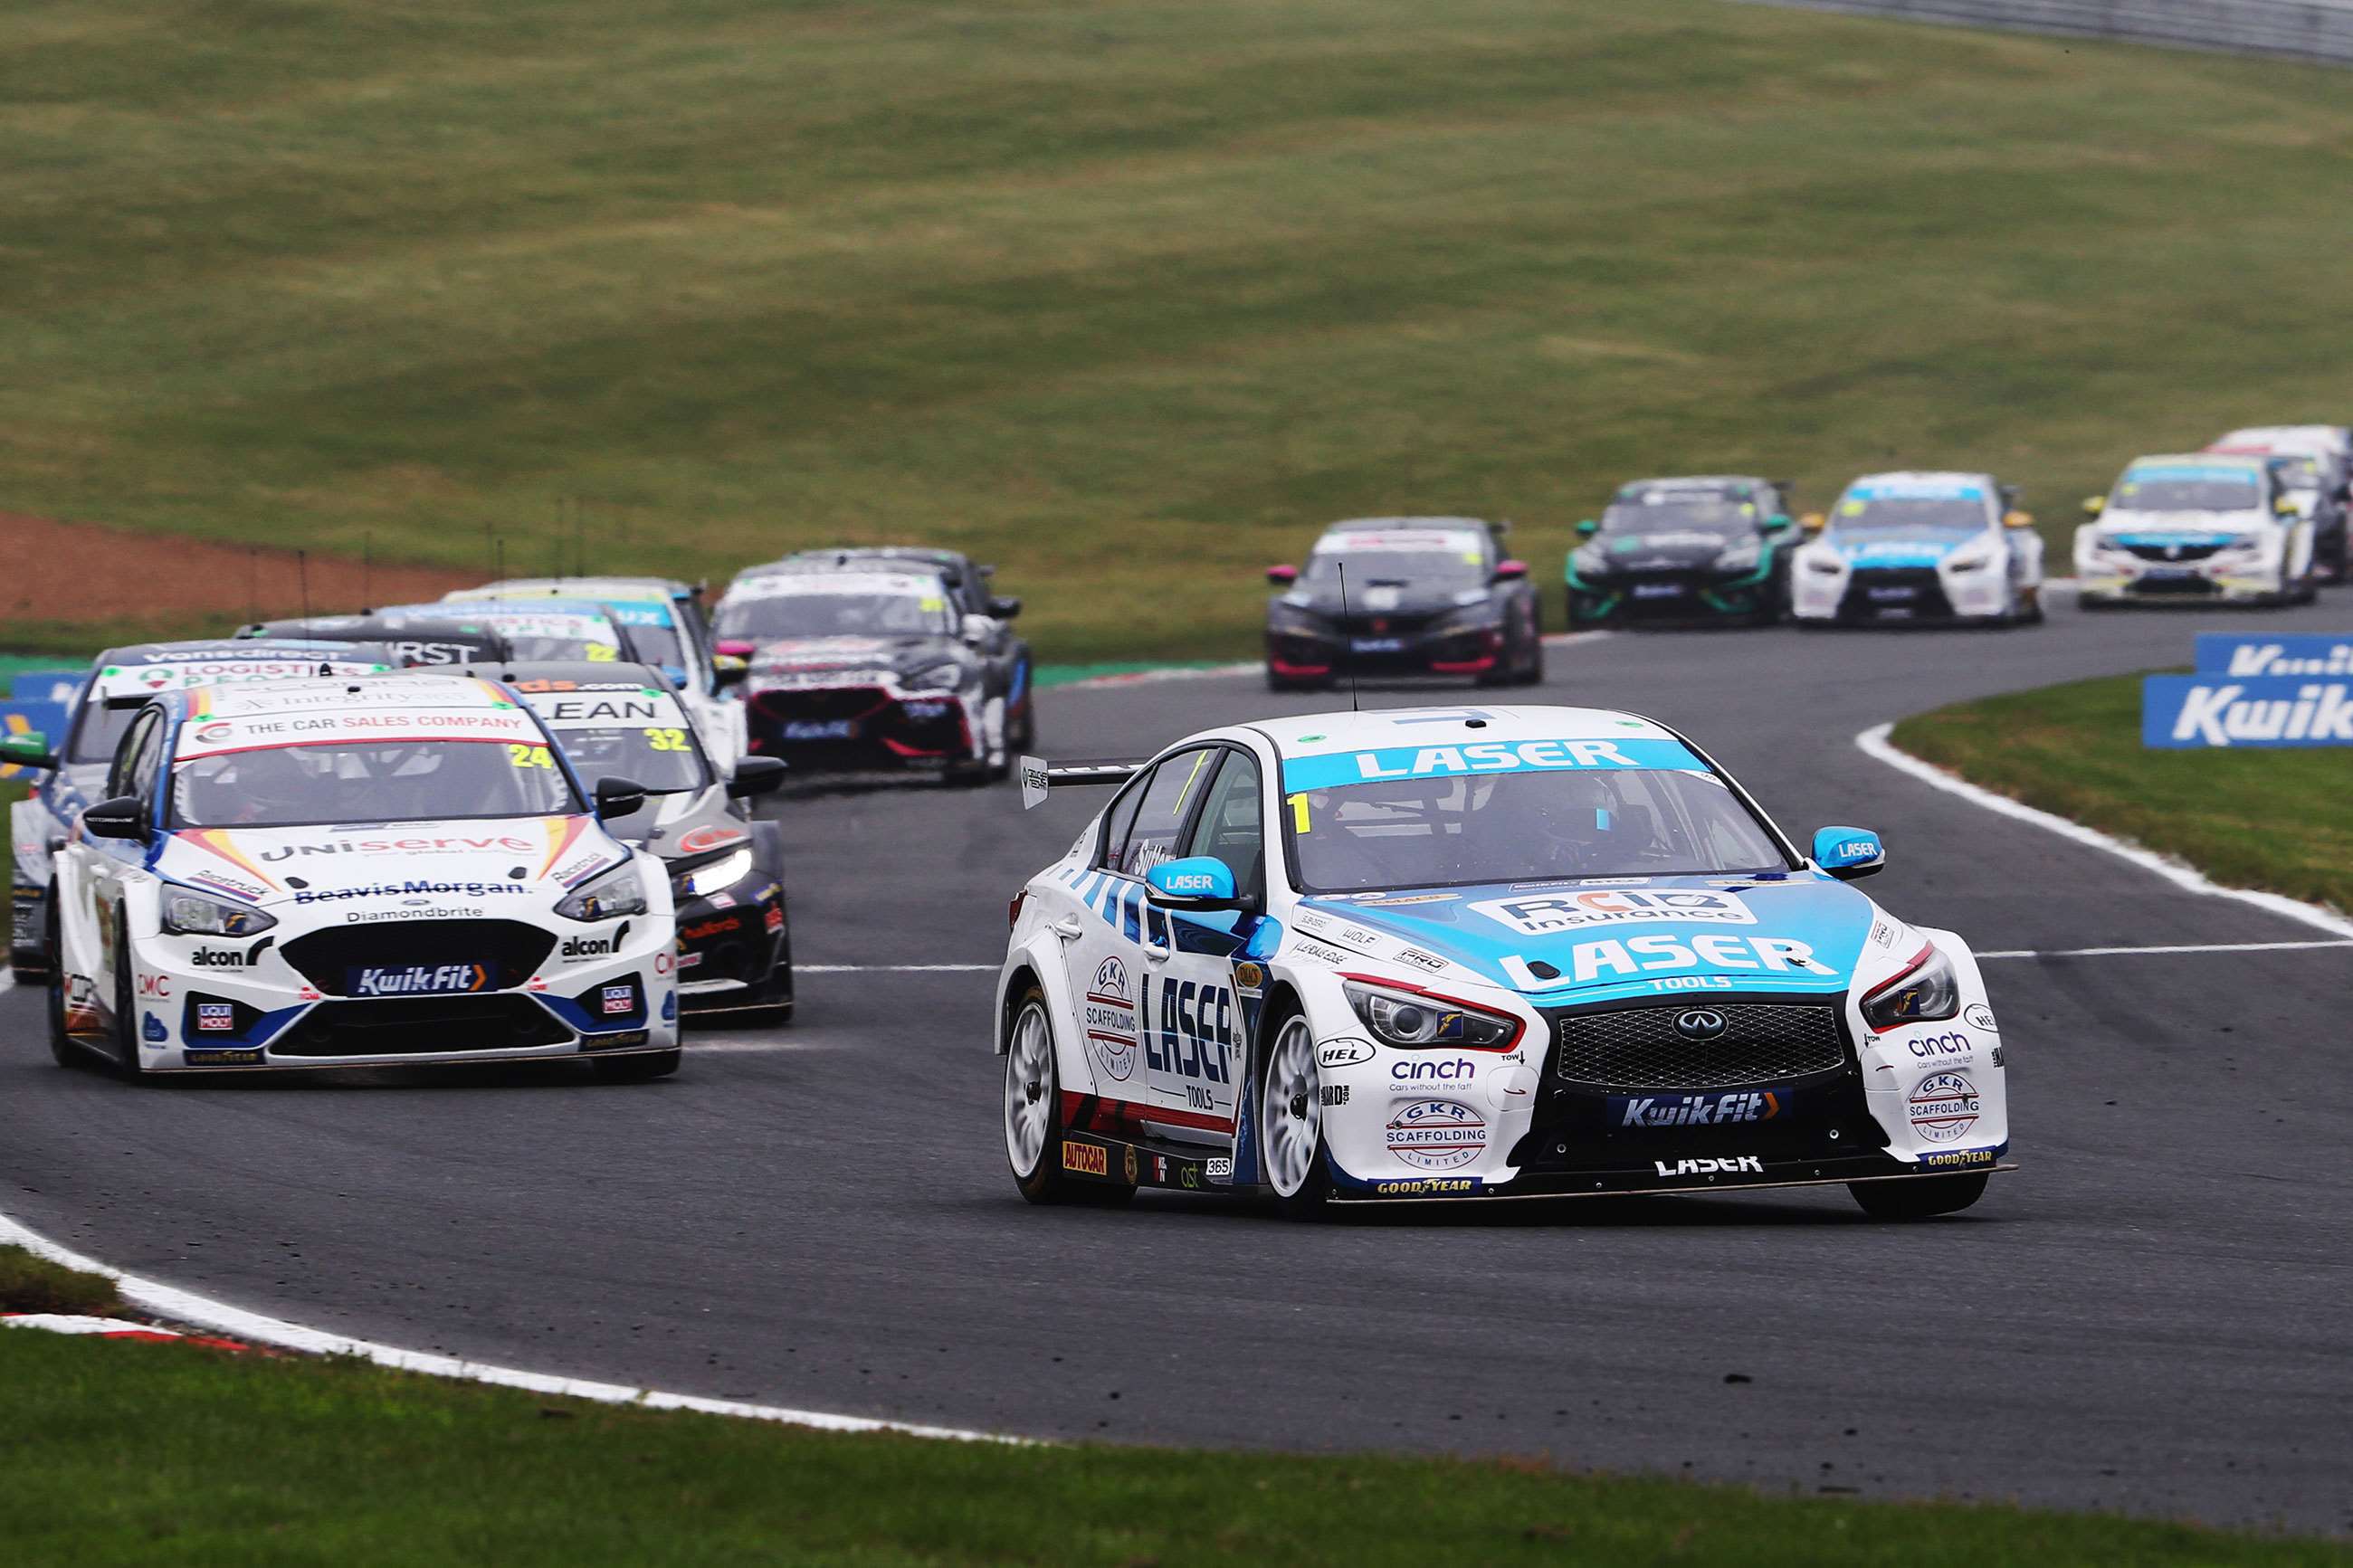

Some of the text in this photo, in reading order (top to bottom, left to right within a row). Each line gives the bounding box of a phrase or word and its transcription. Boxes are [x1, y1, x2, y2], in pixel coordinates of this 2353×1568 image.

[247, 716, 522, 736] THE CAR SALES COMPANY
[643, 728, 692, 752] 32
[508, 744, 554, 769] 24
[1357, 739, 1641, 779] LASER
[1285, 792, 1312, 835] 1
[1837, 841, 1879, 859] LASER
[1165, 874, 1214, 890] LASER
[347, 907, 484, 922] Diamondbrite
[192, 946, 244, 966] alcon
[562, 936, 609, 957] alcon
[1498, 934, 1840, 992] LASER
[1098, 961, 1126, 994] GKR
[1647, 976, 1733, 992] TOOLS
[1086, 1006, 1136, 1032] SCAFFOLDING
[1141, 973, 1233, 1085] LASER
[1908, 1031, 1971, 1058] cinch
[1322, 1049, 1361, 1063] HEL
[1500, 1054, 1519, 1062] TOW
[1391, 1058, 1476, 1080] cinch
[1389, 1083, 1409, 1092] Cars
[1410, 1082, 1442, 1091] without
[1443, 1082, 1456, 1091] the
[1922, 1075, 1964, 1093] GKR
[1186, 1085, 1214, 1110] TOOLS
[1406, 1103, 1466, 1121] GKR
[1910, 1100, 1979, 1117] SCAFFOLDING
[1386, 1129, 1487, 1143] SCAFFOLDING
[1922, 1122, 1966, 1139] LIMITED
[1064, 1143, 1106, 1174] AUTOCAR
[1208, 1160, 1229, 1174] 365
[1407, 1150, 1470, 1166] LIMITED
[1377, 1178, 1472, 1193] GOODYEAR
